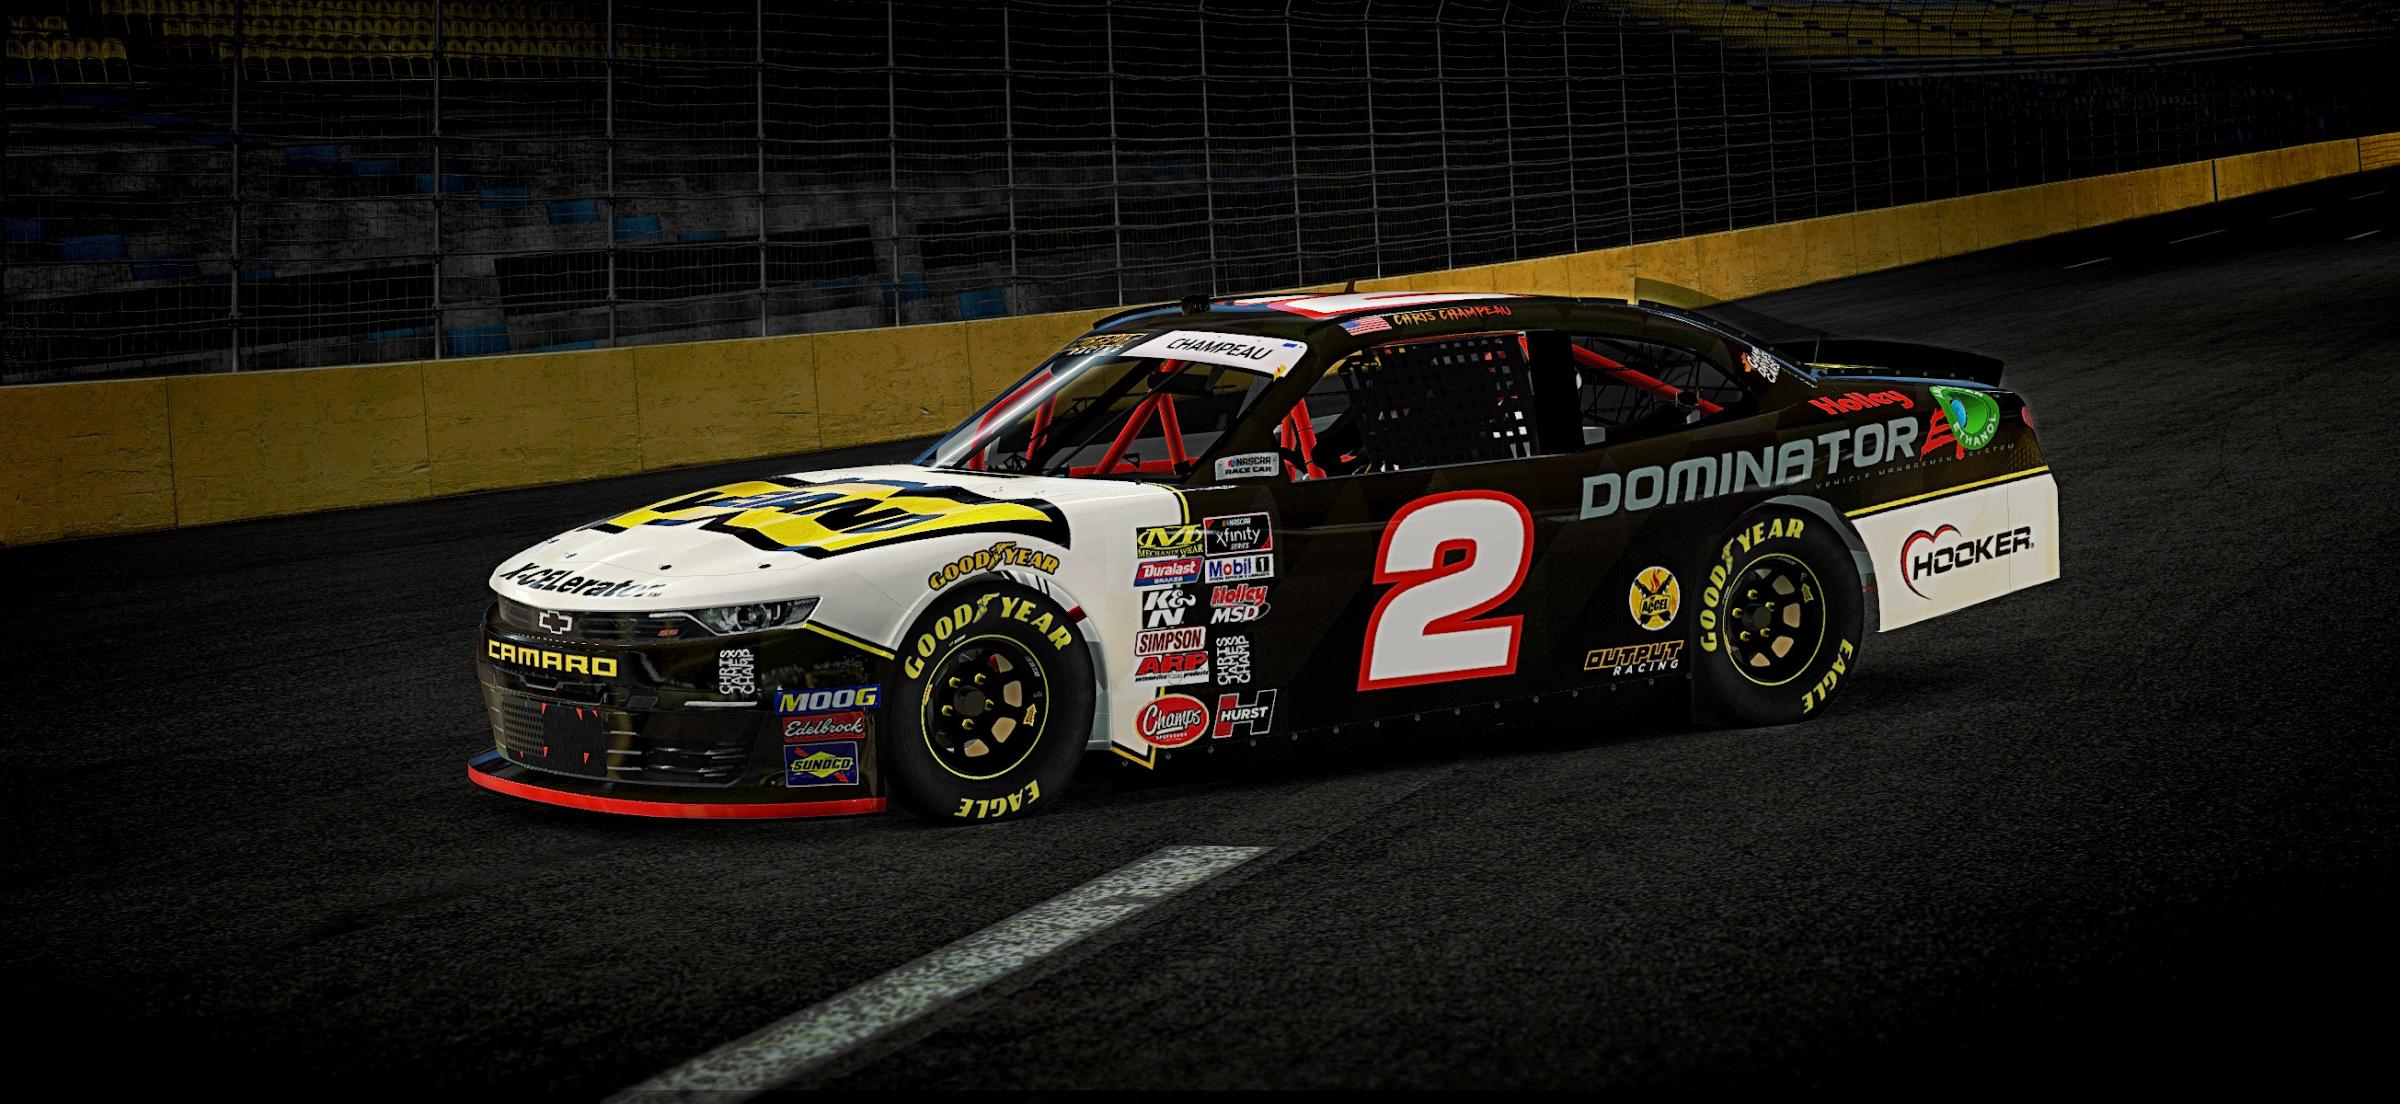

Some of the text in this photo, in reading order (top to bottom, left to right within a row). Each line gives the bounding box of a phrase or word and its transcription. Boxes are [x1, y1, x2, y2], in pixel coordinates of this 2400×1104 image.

[1393, 305, 1513, 327] CHRIS CHAMPEAU
[1166, 337, 1274, 360] CHAMPEAU
[1808, 390, 1914, 415] Holley
[1953, 414, 1997, 447] ETHANOL
[1579, 416, 1919, 521] DOMINATOR
[1878, 454, 1959, 476] MANAGEMEN
[1216, 526, 1261, 547] xfinity
[1180, 544, 1204, 558] WEAR
[1912, 525, 2032, 581] HOOKER
[927, 540, 1060, 591] GOODYEAR
[1143, 561, 1197, 577] Duralast
[1209, 558, 1251, 577] Mobil
[1153, 576, 1184, 584] BRAKES
[1357, 489, 1534, 692] 2
[1699, 517, 1804, 653] GOODYEAR
[1210, 584, 1268, 608] Holley
[1641, 598, 1669, 614] ACCEL
[1210, 605, 1260, 625] MSD
[904, 592, 1073, 680] GOODYEAR
[1138, 629, 1202, 653] SIMPSON
[487, 639, 618, 677] CAMARO
[1135, 652, 1209, 676] ARP
[1216, 636, 1228, 686] CHRIS
[1583, 639, 1685, 671] OUTPUT
[1612, 659, 1680, 677] RACING
[1803, 638, 1853, 714] EAGLE
[779, 687, 879, 713] MOOG
[1142, 703, 1202, 736] Champs
[1220, 705, 1269, 722] HURST
[783, 715, 864, 738] Edelbrock
[792, 757, 854, 772] SUNOCO
[954, 779, 1041, 819] EAGLE
